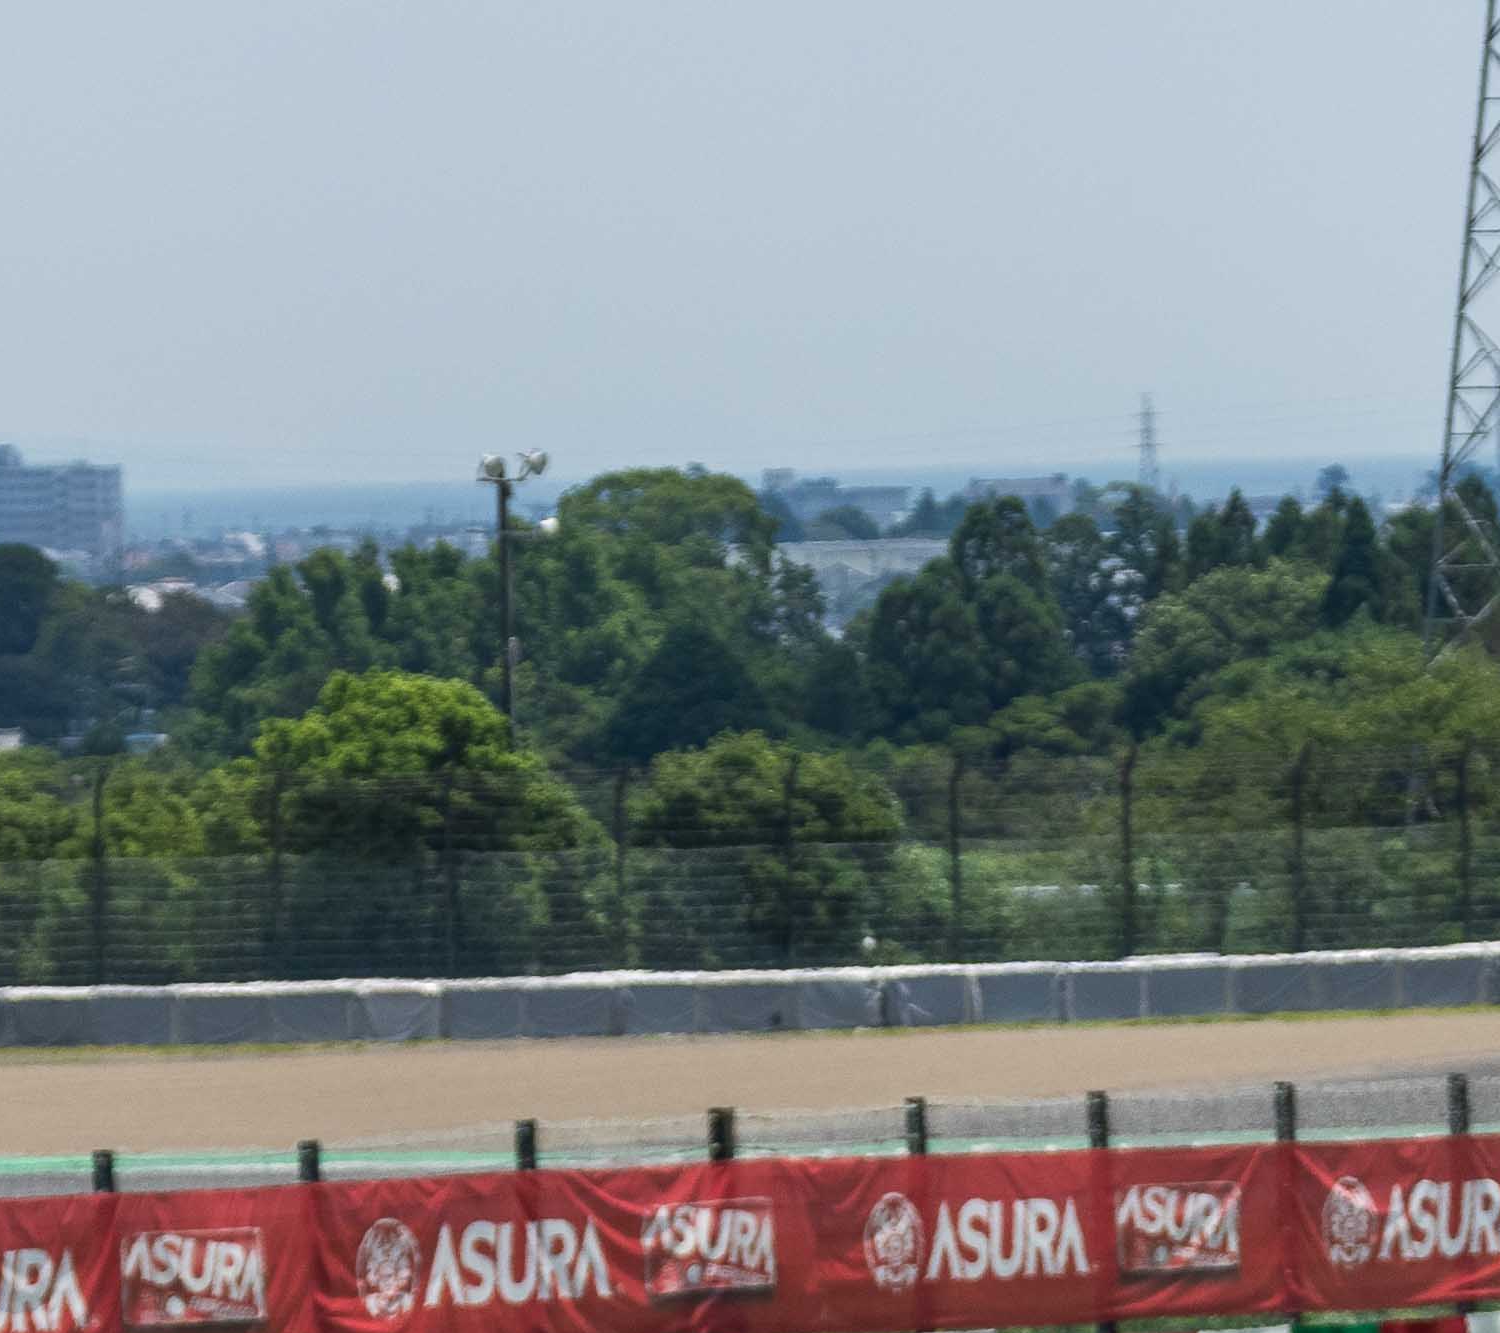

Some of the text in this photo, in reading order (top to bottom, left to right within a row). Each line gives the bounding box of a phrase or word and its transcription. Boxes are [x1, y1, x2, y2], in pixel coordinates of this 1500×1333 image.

[643, 1204, 775, 1273] ASURA
[925, 1196, 1090, 1281] ASURA
[1116, 1185, 1238, 1252] ASURA
[123, 1233, 265, 1302] ASURA
[422, 1218, 613, 1307] ASURA
